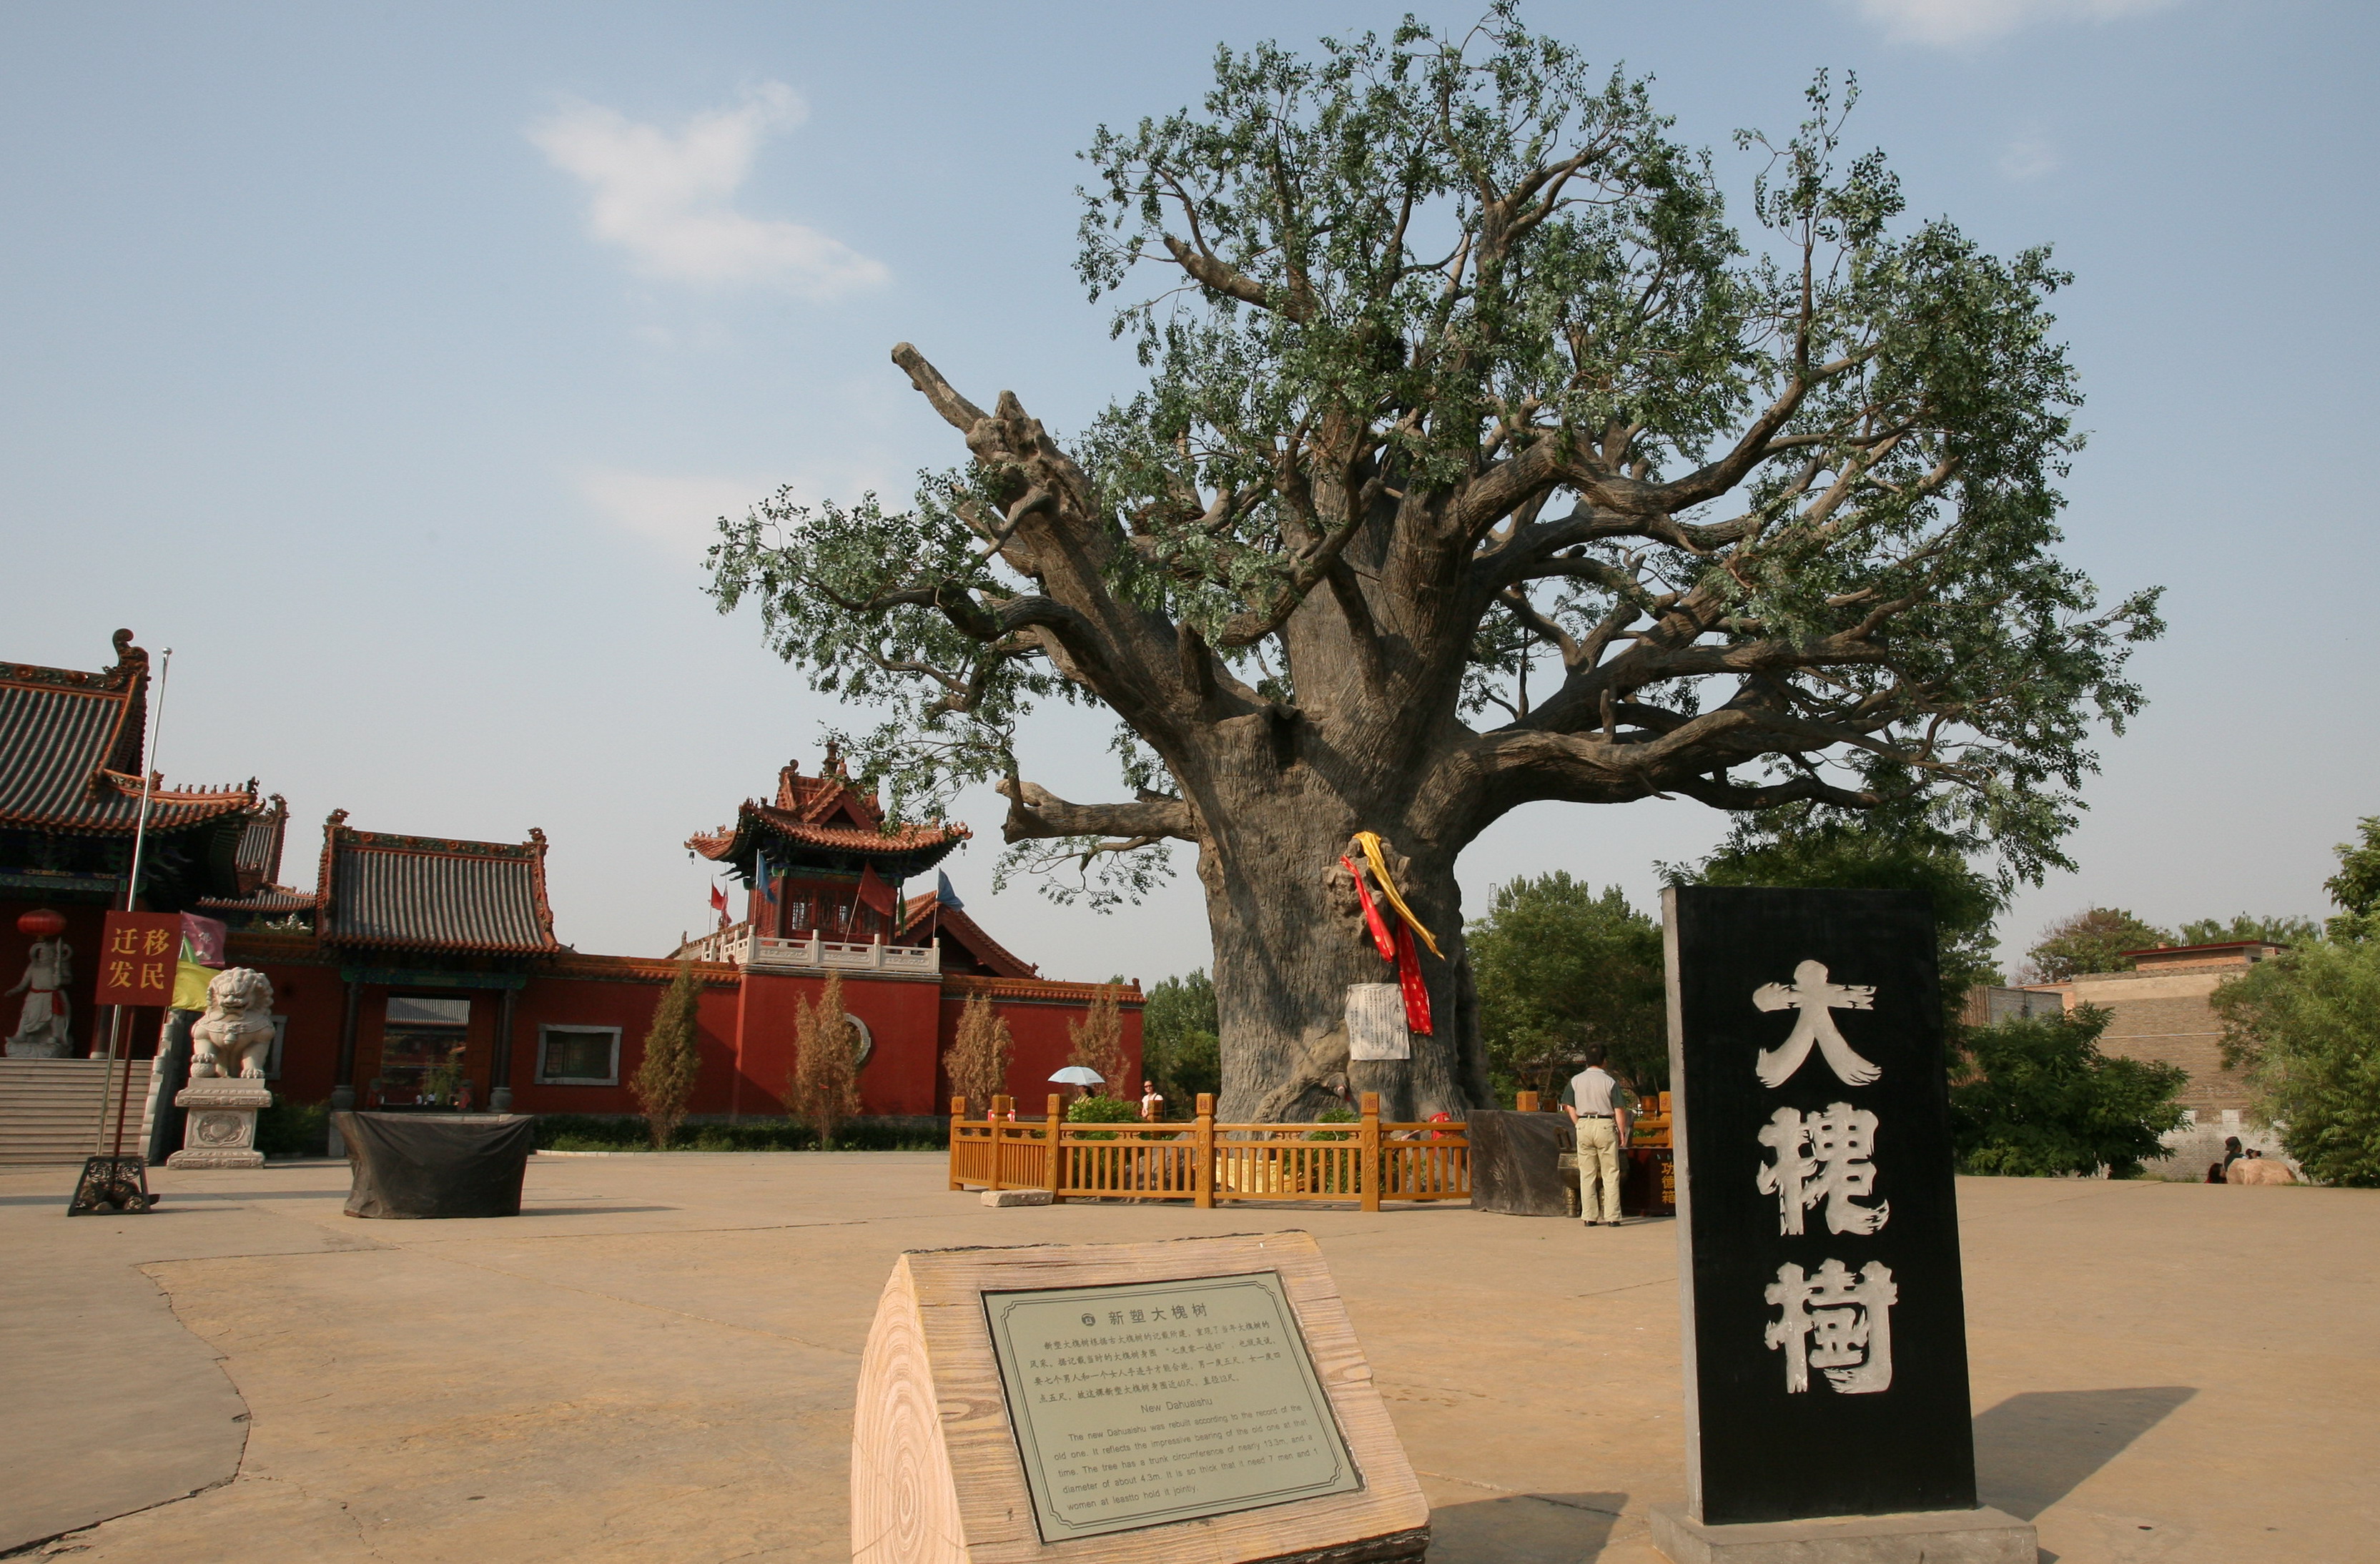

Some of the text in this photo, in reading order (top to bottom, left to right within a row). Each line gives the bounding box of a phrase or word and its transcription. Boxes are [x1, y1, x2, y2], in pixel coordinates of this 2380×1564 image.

[1661, 1162, 1676, 1204] 功德箱
[1108, 1303, 1207, 1325] 新塑大槐树
[1068, 1433, 1084, 1442] The
[1087, 1431, 1103, 1440] new
[1107, 1425, 1147, 1437] Dahuaishu
[1169, 1419, 1191, 1429] rebuilt
[1195, 1415, 1228, 1426] according
[1241, 1411, 1253, 1420] the
[1256, 1407, 1278, 1417] record
[1280, 1405, 1287, 1414] of
[1140, 1397, 1213, 1414] New Dahuaishu
[1054, 1451, 1066, 1461] old
[1071, 1450, 1087, 1459] one.
[1102, 1444, 1131, 1455] reflects
[1135, 1442, 1147, 1450] the
[1151, 1436, 1191, 1448] impressive
[1195, 1432, 1223, 1442] bearing
[1226, 1428, 1233, 1437] of
[1252, 1425, 1263, 1434] old
[1266, 1423, 1280, 1432] one
[1293, 1418, 1308, 1427] that
[1058, 1469, 1077, 1478] time.
[1082, 1465, 1098, 1474] The
[1102, 1463, 1117, 1472] tree
[1121, 1460, 1136, 1469] has
[1149, 1455, 1169, 1465] trunk
[1172, 1448, 1224, 1462] circumference
[1228, 1445, 1234, 1453] of
[1238, 1442, 1260, 1451] nearly
[1291, 1435, 1304, 1444] and
[1063, 1483, 1097, 1495] diameter
[1102, 1479, 1110, 1489] of
[1115, 1476, 1137, 1487] about
[1141, 1473, 1161, 1483] 4.3m.
[1166, 1470, 1172, 1479] It
[1175, 1469, 1182, 1478] is
[1199, 1463, 1218, 1473] thick
[1221, 1461, 1235, 1470] that
[1248, 1456, 1265, 1466] need
[1278, 1452, 1293, 1461] men
[1297, 1449, 1310, 1458] and
[1067, 1500, 1096, 1511] women
[1101, 1497, 1109, 1506] at
[1143, 1489, 1160, 1499] hold
[1165, 1488, 1170, 1496] it
[1173, 1485, 1198, 1497] jointly.
